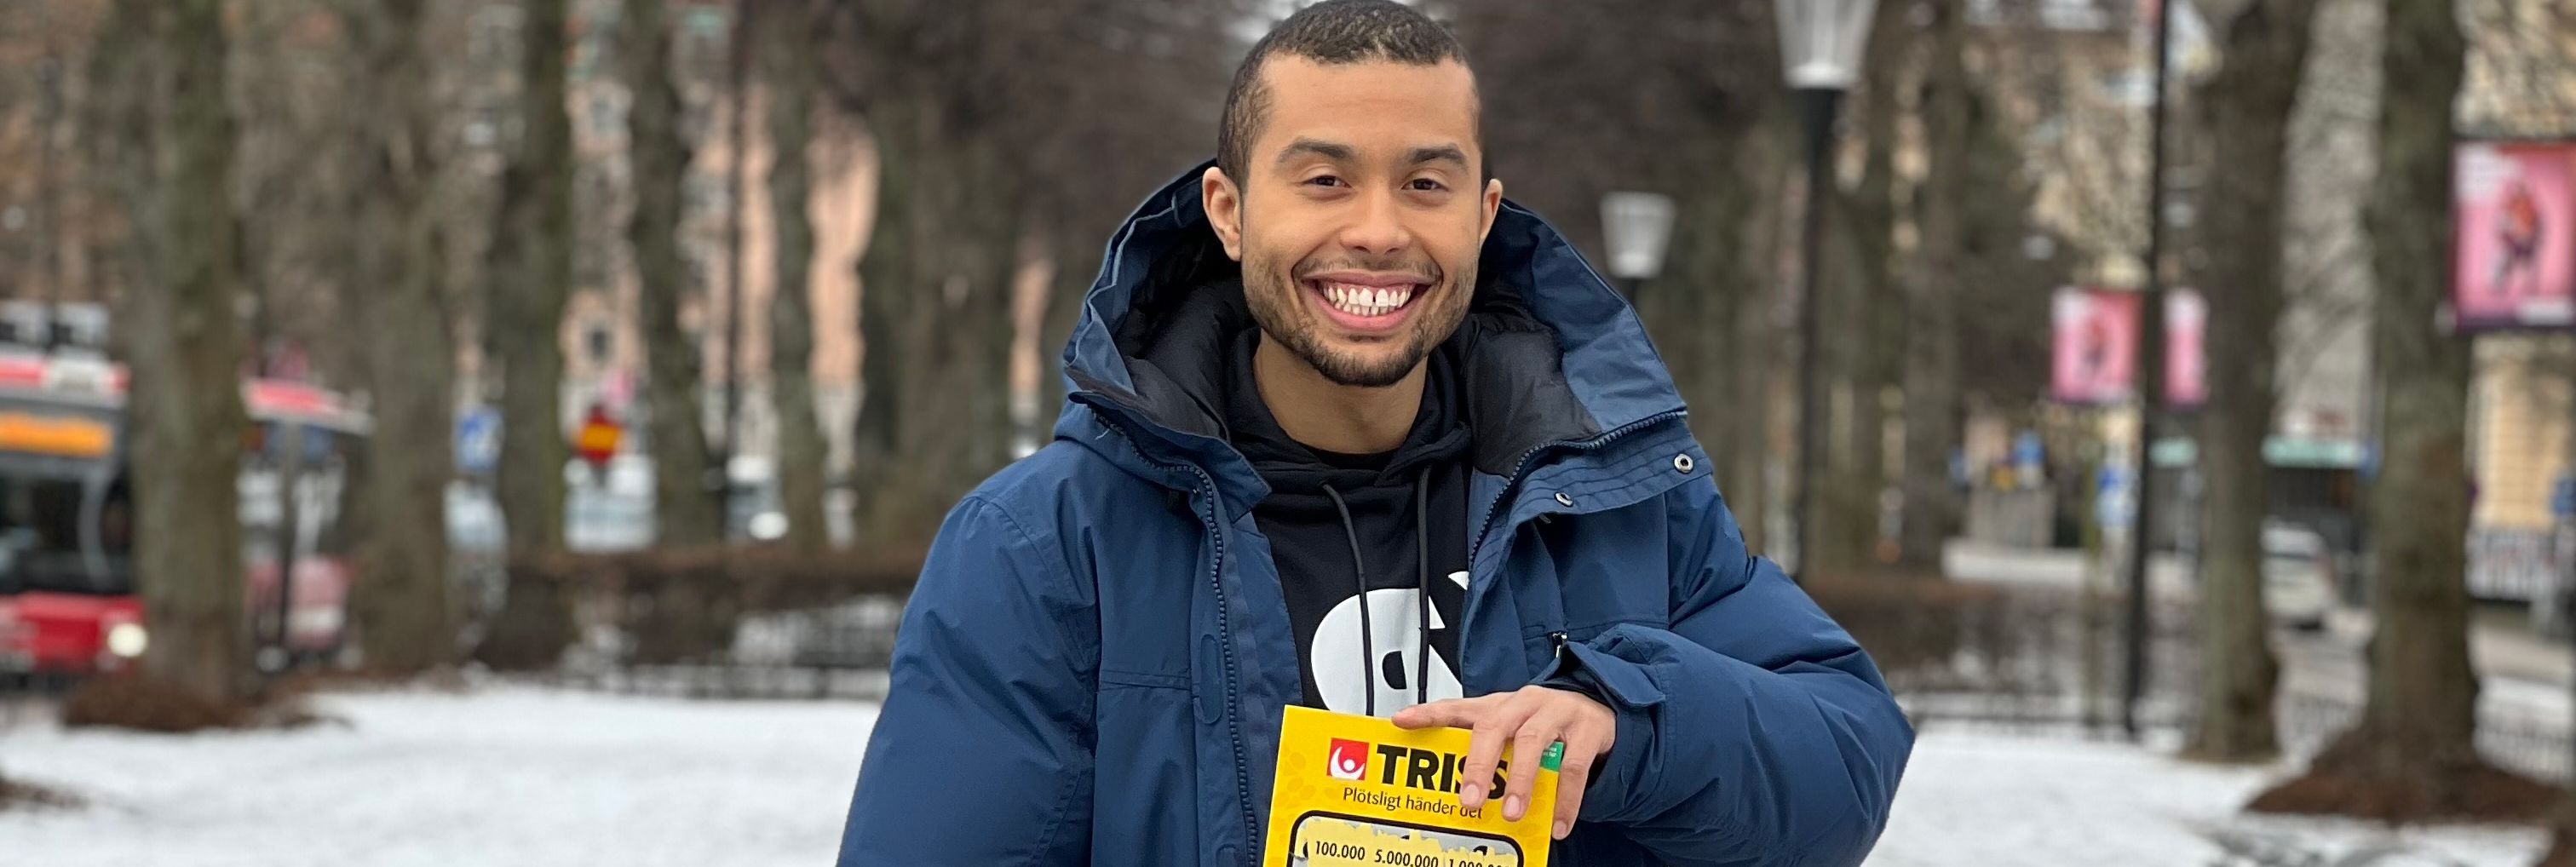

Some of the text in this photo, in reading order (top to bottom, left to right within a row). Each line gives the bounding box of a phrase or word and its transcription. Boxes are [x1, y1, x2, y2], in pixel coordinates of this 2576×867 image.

[1343, 787, 1401, 811] Plötsligt
[1406, 794, 1458, 815] händer
[1315, 841, 1366, 861] 100.000
[1374, 848, 1440, 867] 5.000.000
